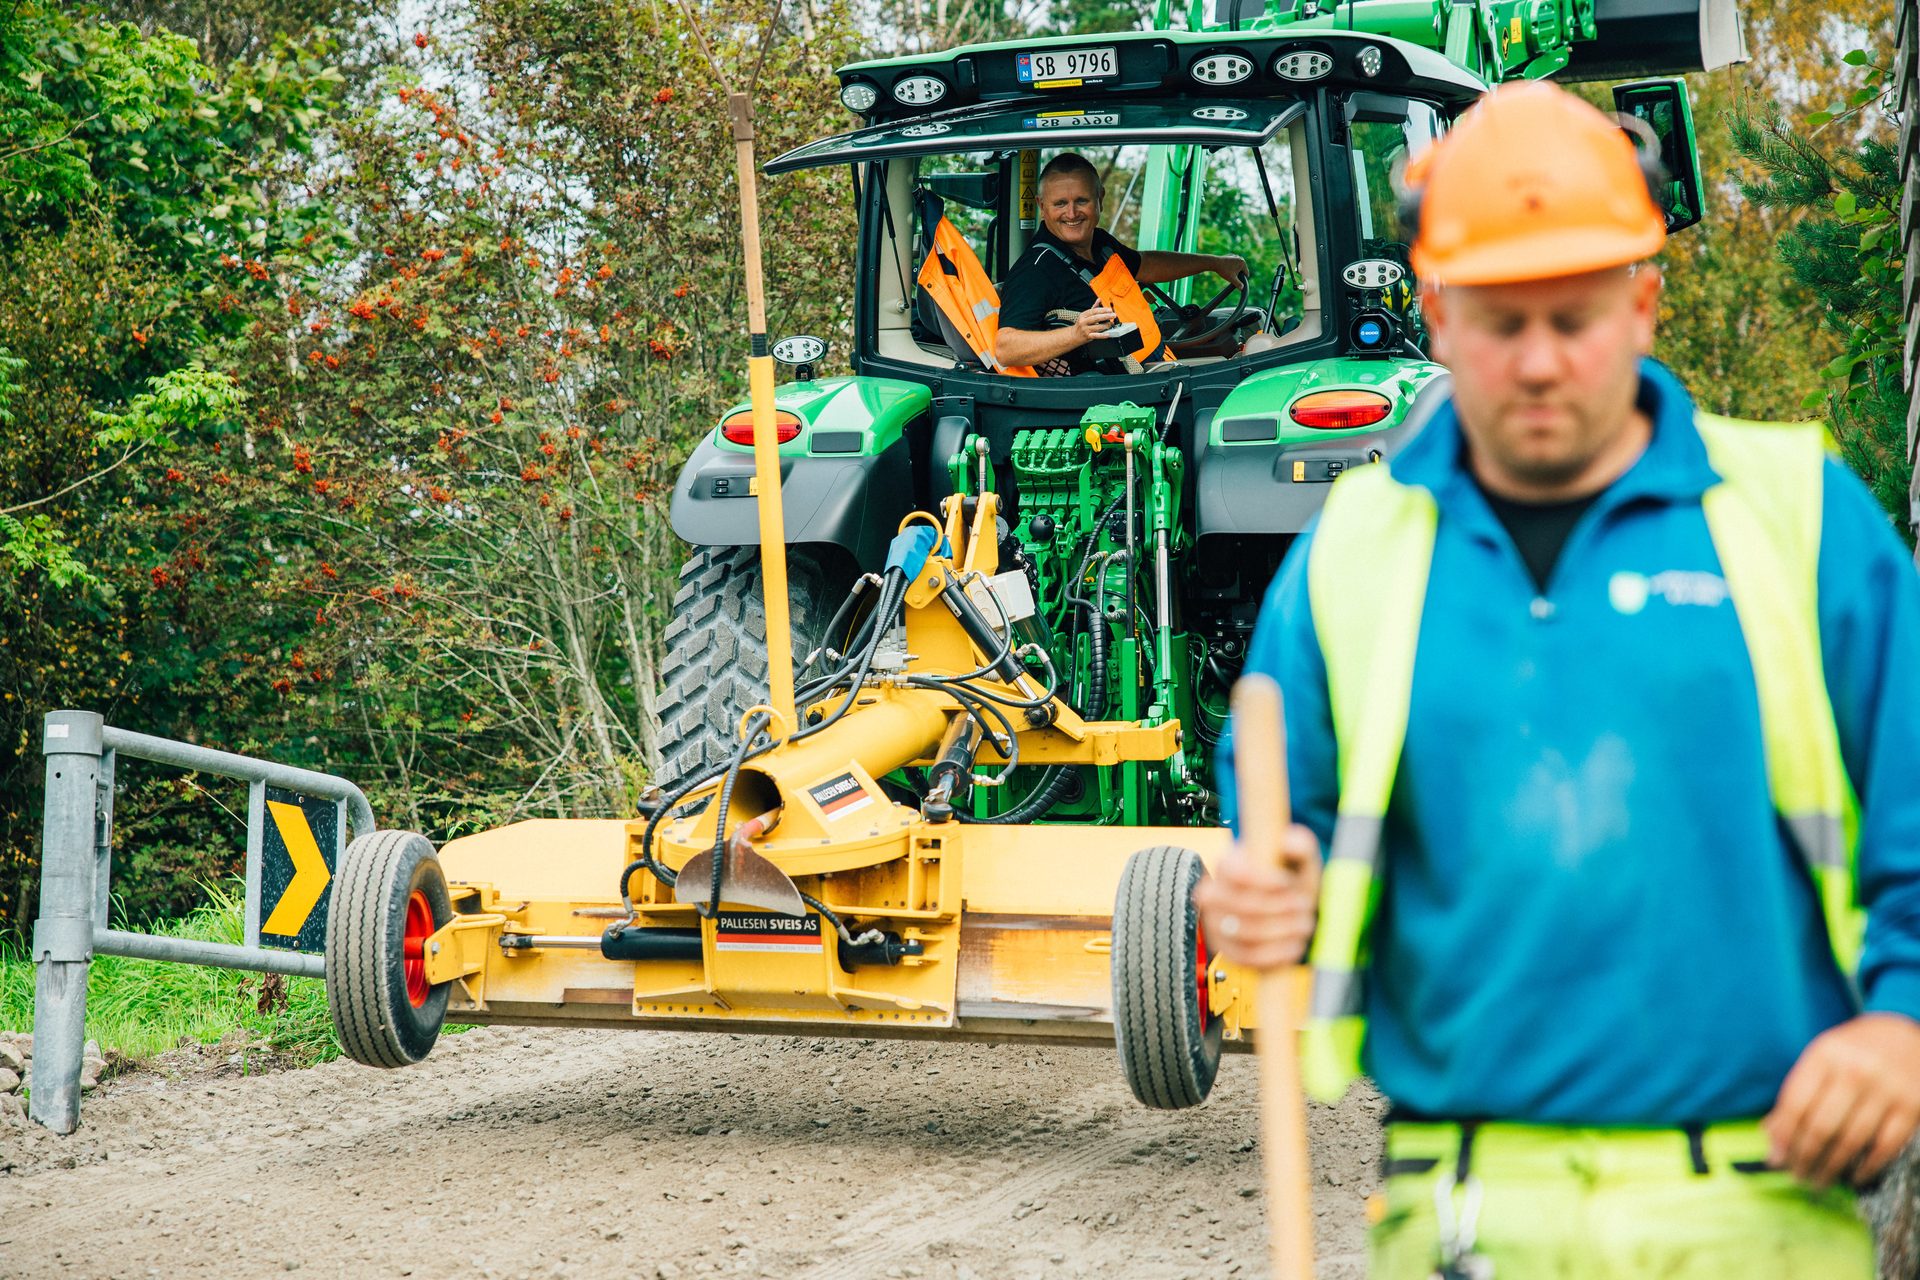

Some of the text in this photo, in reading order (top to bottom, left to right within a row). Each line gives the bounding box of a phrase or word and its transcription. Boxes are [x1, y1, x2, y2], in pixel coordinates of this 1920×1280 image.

[1036, 52, 1110, 76] SB 9796
[720, 917, 817, 931] PALLESEN SVEIS AS
